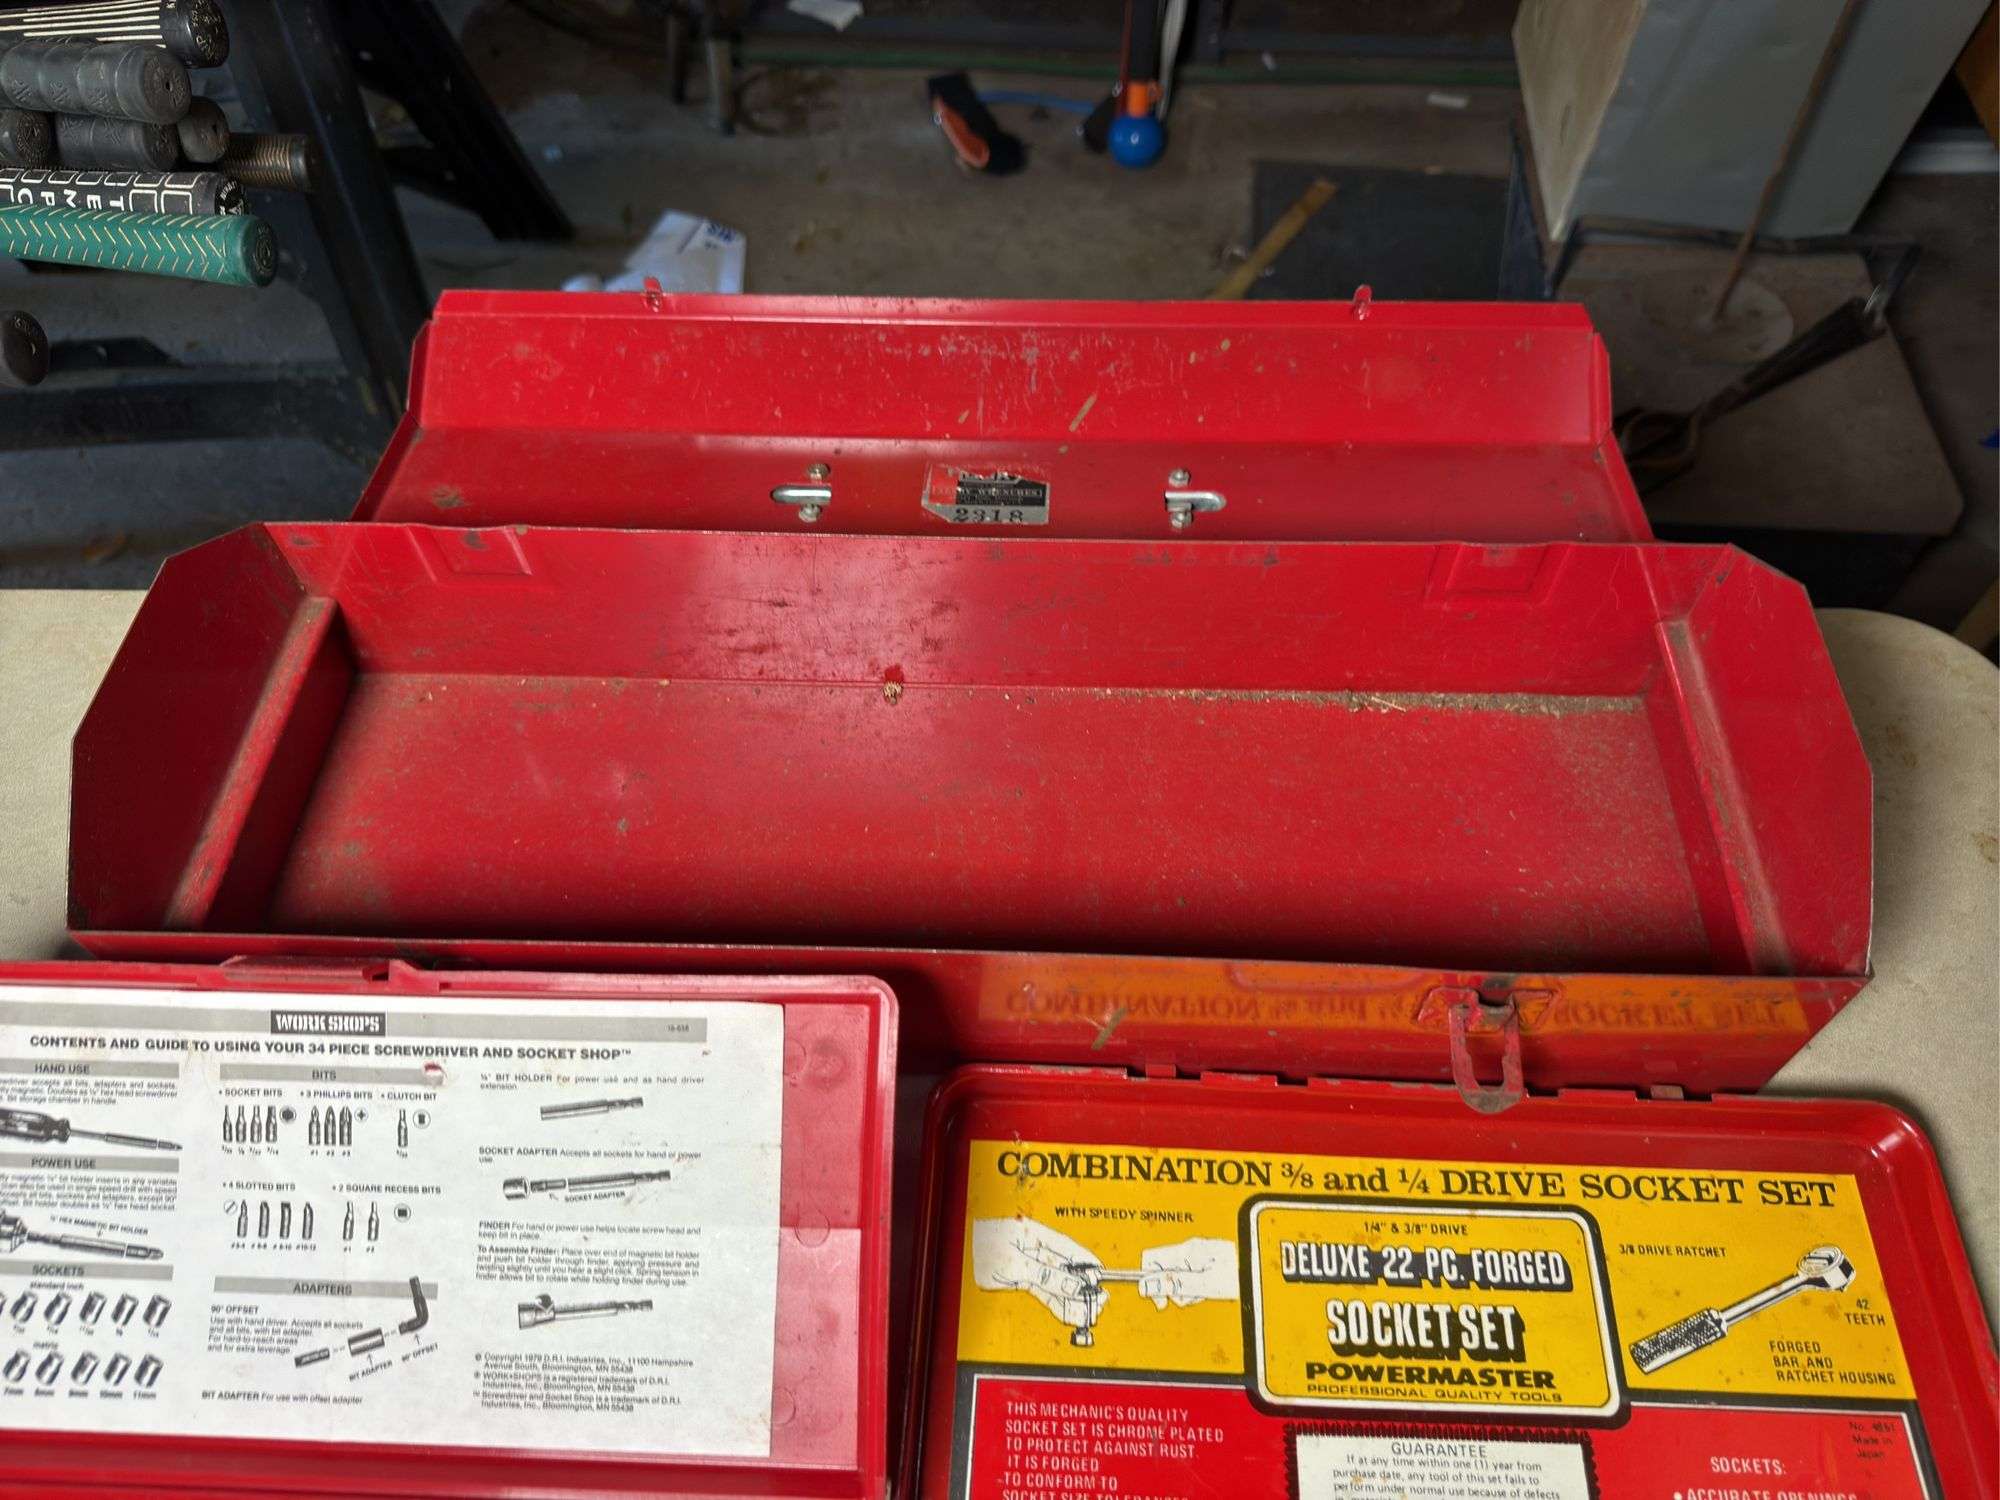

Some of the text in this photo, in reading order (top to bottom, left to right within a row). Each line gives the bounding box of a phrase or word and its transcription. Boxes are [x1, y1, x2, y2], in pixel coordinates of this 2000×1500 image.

[275, 1014, 379, 1032] WORK SHOPS
[29, 1035, 106, 1048] CONTENTS
[110, 1037, 139, 1049] AND
[144, 1038, 189, 1051] GUIDE
[191, 1039, 210, 1052] TO
[214, 1040, 260, 1052] USING
[264, 1041, 304, 1053] YOUR
[308, 1042, 325, 1054] 34
[328, 1043, 369, 1055] PIECE
[374, 1044, 478, 1057] SCREWDRIVER
[482, 1046, 513, 1058] AND
[516, 1047, 576, 1059] SOCKET
[34, 1062, 90, 1075] HAND USE
[311, 1069, 336, 1080] BITS
[495, 1072, 511, 1084] BIT
[513, 1072, 552, 1084] HOLDER
[556, 1074, 570, 1085] For
[574, 1075, 599, 1084] power
[603, 1074, 618, 1083] use
[622, 1076, 638, 1084] and
[642, 1076, 652, 1084] as
[656, 1076, 677, 1084] hand
[680, 1075, 704, 1084] driver
[224, 1087, 282, 1097] SOCKET BITS
[313, 1089, 351, 1099] PHILLIPS
[353, 1090, 372, 1100] BITS
[386, 1091, 436, 1101] CLUTCH BIT
[478, 1146, 514, 1155] SOCKET
[516, 1146, 558, 1156] ADAPTER
[559, 1147, 590, 1158] Accepts
[592, 1149, 601, 1157] all
[603, 1150, 632, 1158] sockets
[646, 1150, 666, 1159] hand
[676, 1151, 701, 1160] power
[31, 1157, 96, 1169] POWER USE
[998, 1151, 1272, 1186] COMBINATION
[1323, 1166, 1390, 1192] and
[1438, 1169, 1566, 1197] DRIVE
[1579, 1173, 1744, 1204] SOCKET
[1757, 1179, 1835, 1207] SET
[235, 1181, 274, 1190] SLOTTED
[275, 1182, 295, 1192] BITS
[345, 1183, 382, 1193] SQUARE
[384, 1184, 419, 1194] RECESS
[421, 1185, 441, 1194] BITS
[564, 1190, 625, 1203] SOCKET ADAPTER
[1054, 1206, 1194, 1222] WITH SPEEDY SPINNER
[1390, 1222, 1399, 1234] &
[1430, 1223, 1468, 1236] DRIVE
[1637, 1244, 1672, 1256] DRIVE
[1674, 1245, 1725, 1258] RATCHET
[31, 1264, 86, 1277] SOCKETS
[1280, 1242, 1567, 1286] DELUXE 22 PC. FORGED
[30, 1281, 65, 1290] standard
[292, 1282, 352, 1296] ADAPTERS
[225, 1304, 258, 1314] OFFSET
[1855, 1298, 1870, 1310] 42
[1327, 1300, 1516, 1351] SOCKET SET
[1843, 1312, 1885, 1326] TEETH
[1768, 1340, 1821, 1354] FORGED
[1773, 1355, 1833, 1370] BAR AND
[1305, 1362, 1556, 1389] POWERMASTER
[1775, 1370, 1896, 1385] RATCHET HOUSING
[1305, 1383, 1562, 1402] PROFESSIONAL QUALITY TOOLS
[1007, 1400, 1188, 1424] THIS MECHANIC'S QUALITY
[1005, 1419, 1223, 1442] SOCKET SET IS CHROME PLATED
[1006, 1436, 1198, 1458] TO PROTECT AGAINST RUST.
[1390, 1441, 1487, 1460] GUARANTEE
[1007, 1454, 1099, 1472] IT IS FORGED
[1346, 1453, 1542, 1472] If at any time within one (1) year from
[1710, 1456, 1786, 1475] SOCKETS:
[1004, 1472, 1118, 1491] TO CONFORM TO
[1332, 1468, 1539, 1486] purchase date, any tool of this set fails to
[1002, 1490, 1055, 1500] SOCKET
[1333, 1482, 1560, 1500] perform under normal use because of defects
[1687, 1488, 1770, 1500] ACCURATE
